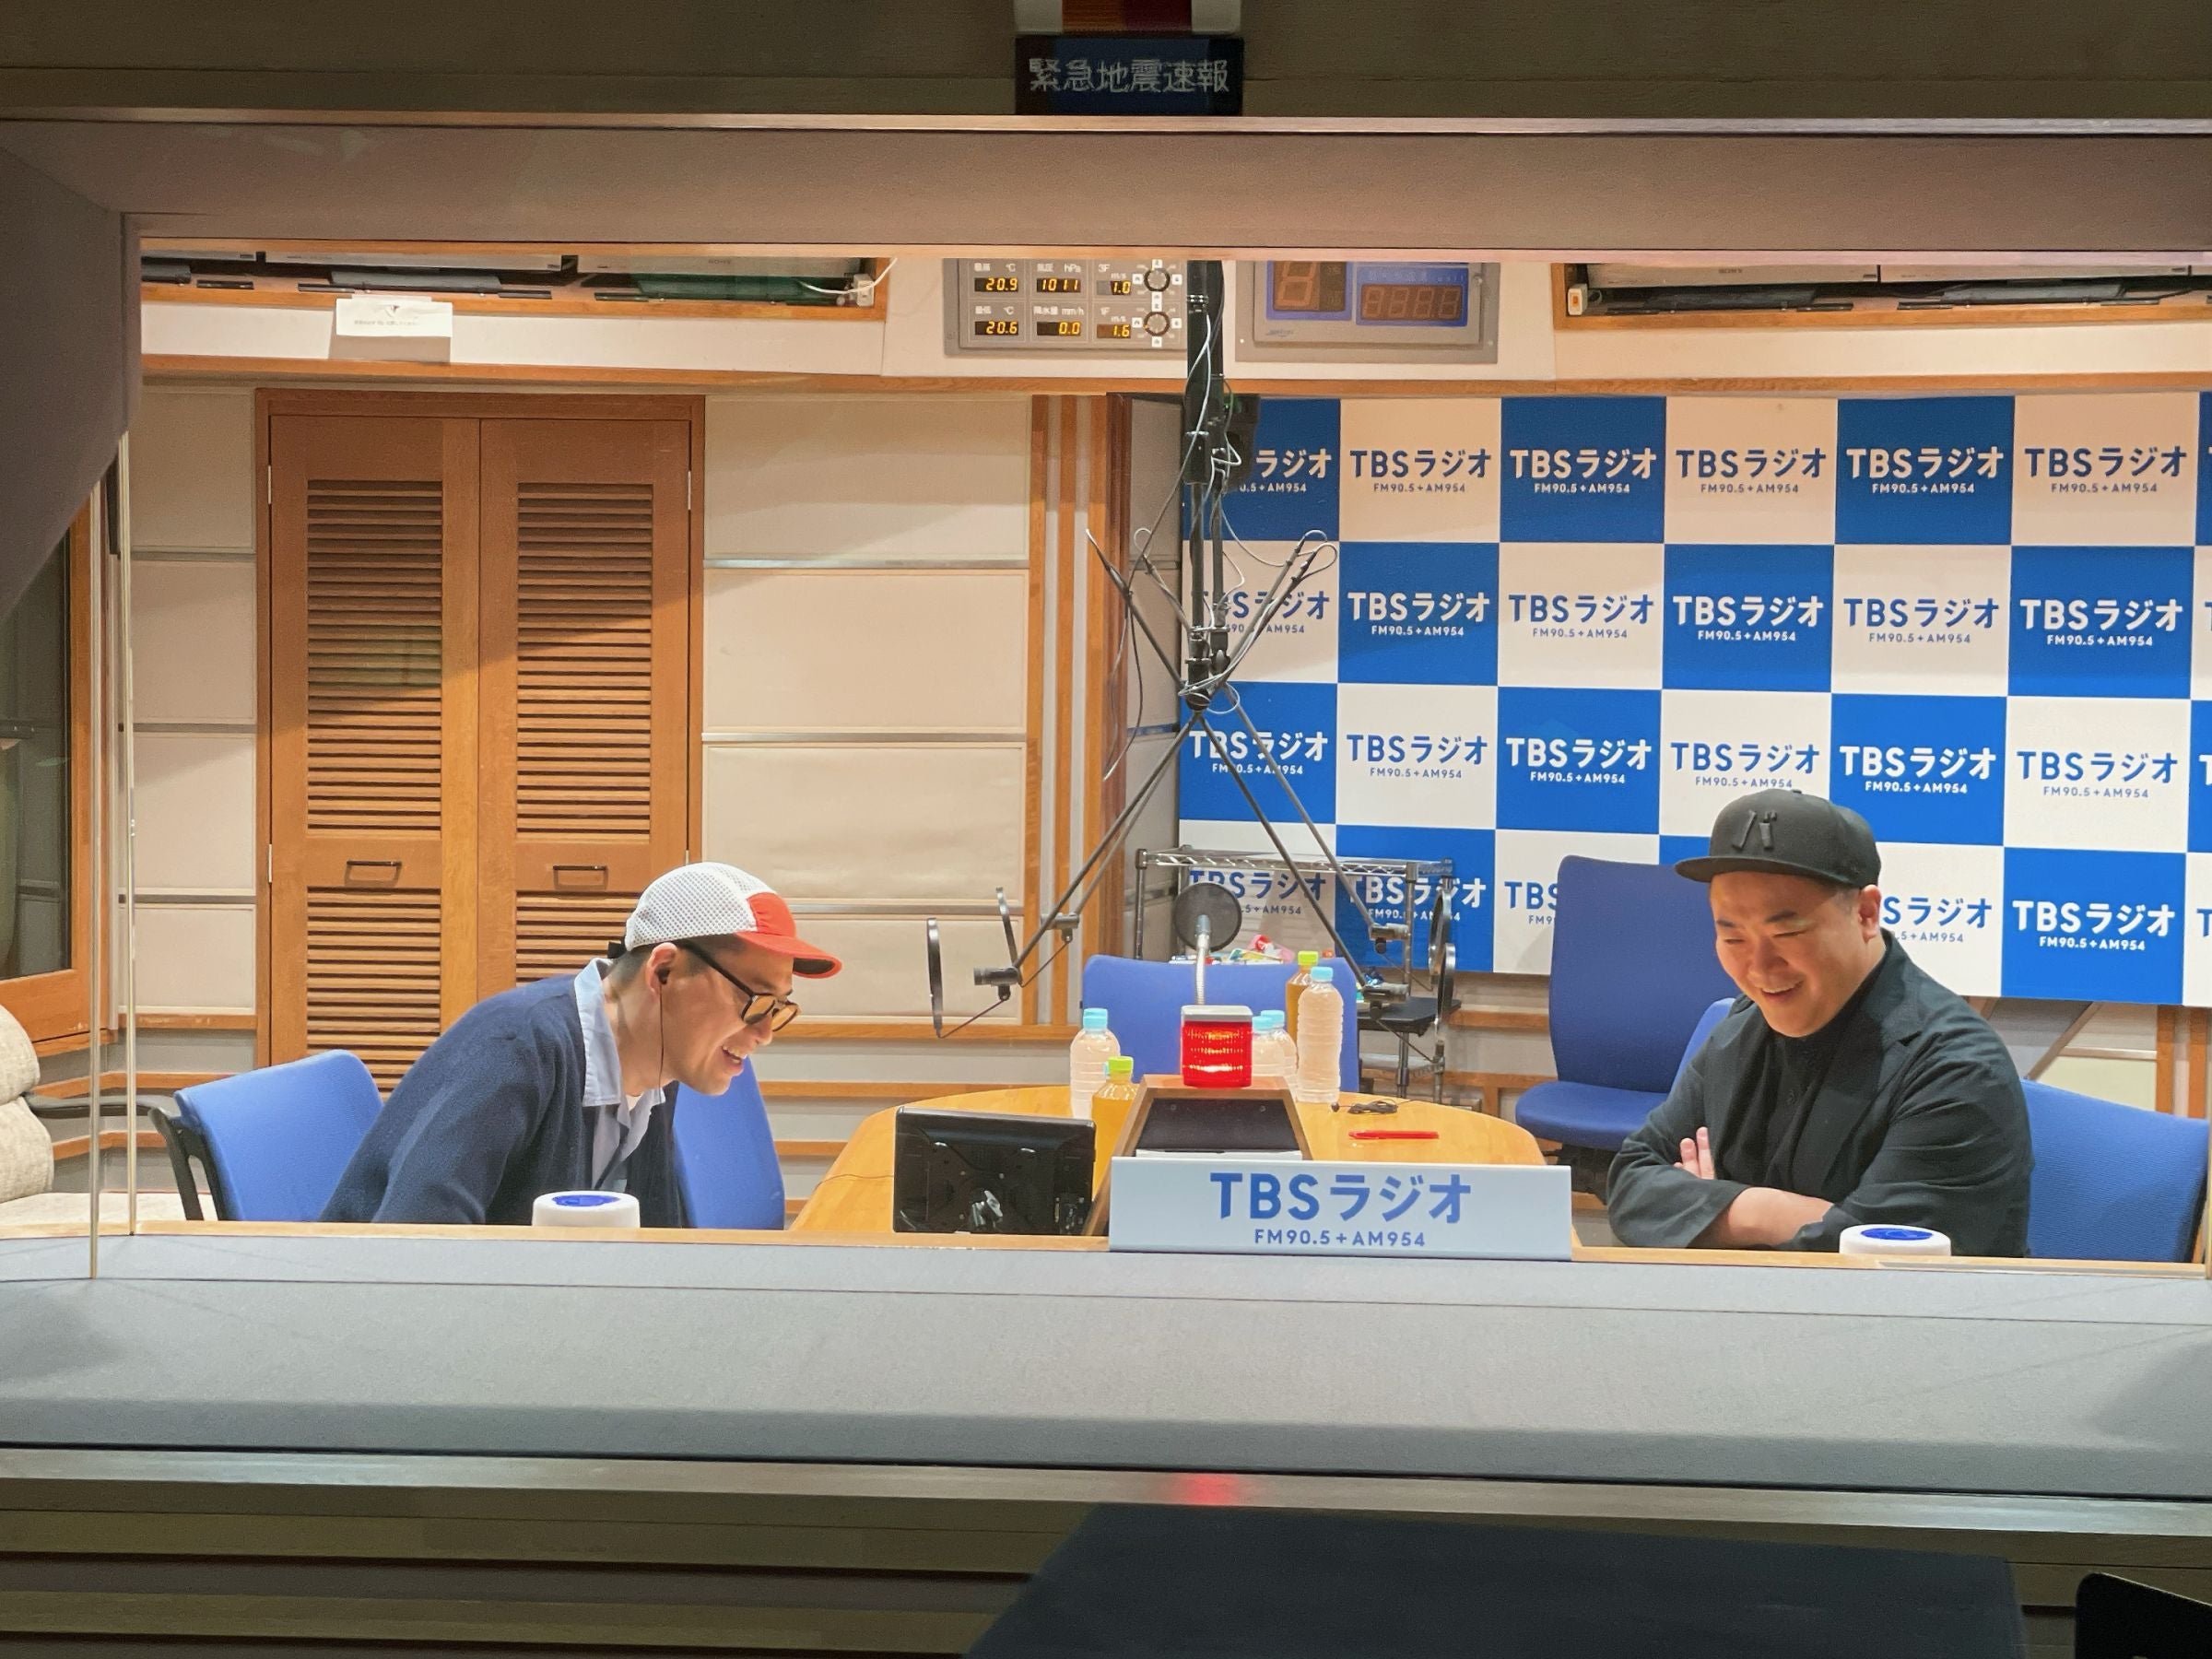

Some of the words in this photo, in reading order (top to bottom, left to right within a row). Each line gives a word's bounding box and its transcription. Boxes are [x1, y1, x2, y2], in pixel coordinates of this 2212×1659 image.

[1029, 58, 1230, 93] 緊急地震速報
[985, 277, 1018, 291] 20.9
[1041, 278, 1079, 291] 1011
[1113, 281, 1132, 294] 1.0
[985, 321, 1018, 335] 20.6
[1058, 322, 1081, 335] 0.0
[1113, 324, 1131, 338] 1.6
[1255, 447, 1332, 479] ラジオ
[1349, 448, 1492, 478] TBSラジオ
[1509, 447, 1657, 479] TBSラジオ
[1675, 447, 1827, 478] TBSラジオ
[1846, 445, 2005, 479] TBSラジオ
[2024, 445, 2187, 478] TBSラジオ
[1347, 592, 1490, 622] TBSラジオ
[1508, 594, 1654, 624] TBSラジオ
[1673, 595, 1824, 628] TBSラジオ
[1843, 597, 2000, 629] TBSラジオ
[2019, 598, 2183, 632] TBSラジオ
[1346, 734, 1488, 765] TBSラジオ
[1505, 737, 1653, 771] TBSラジオ
[1670, 742, 1820, 774] TBSラジオ
[1839, 745, 1996, 780] TBSラジオ
[2016, 750, 2179, 784] TBSラジオ
[1882, 896, 1993, 928] Sラジオ
[2012, 900, 2175, 937] TBSラジオ
[1209, 1171, 1472, 1224] TBSラジオ
